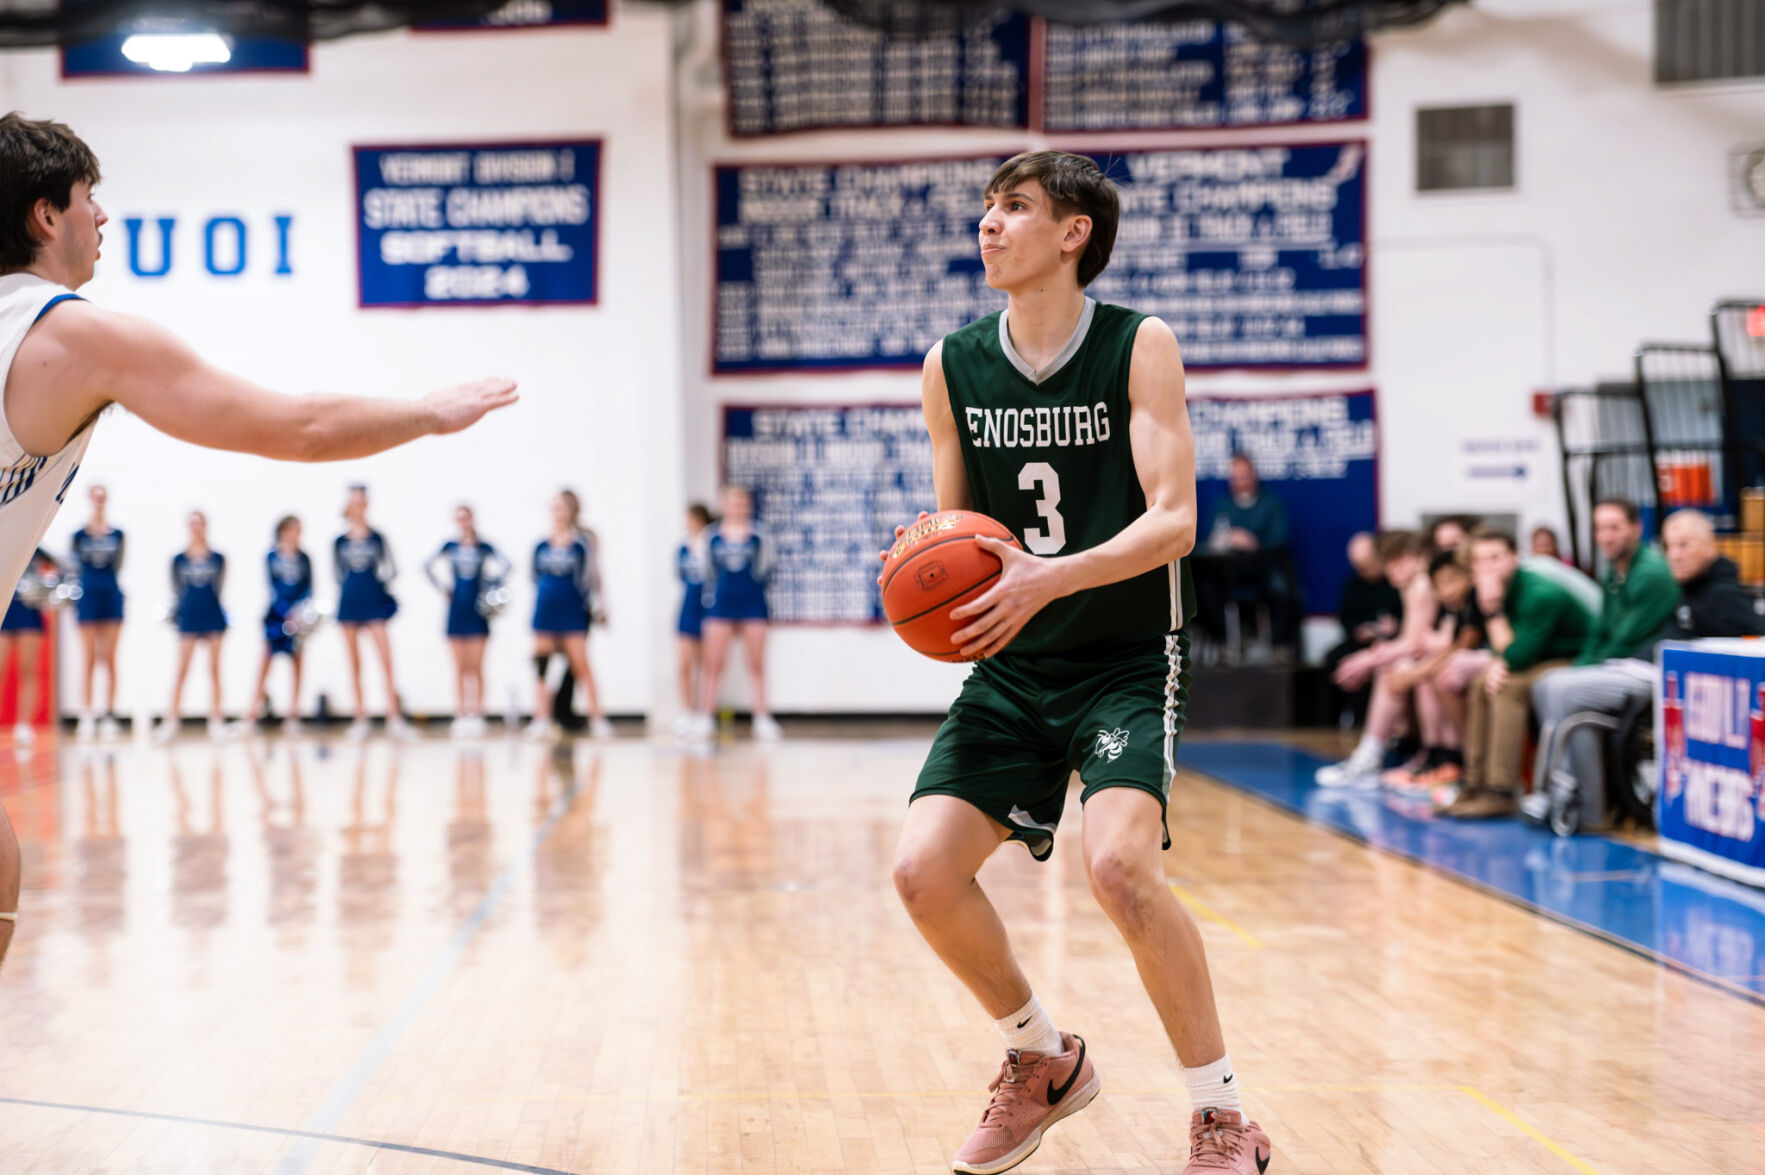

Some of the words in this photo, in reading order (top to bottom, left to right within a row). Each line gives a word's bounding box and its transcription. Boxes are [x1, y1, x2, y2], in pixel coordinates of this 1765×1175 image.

[364, 187, 443, 228] STATE
[448, 185, 589, 226] CHAMPIONS
[381, 229, 572, 264] SOFTBALL
[966, 402, 1110, 448] ENOSBURG
[1018, 462, 1066, 554] 3
